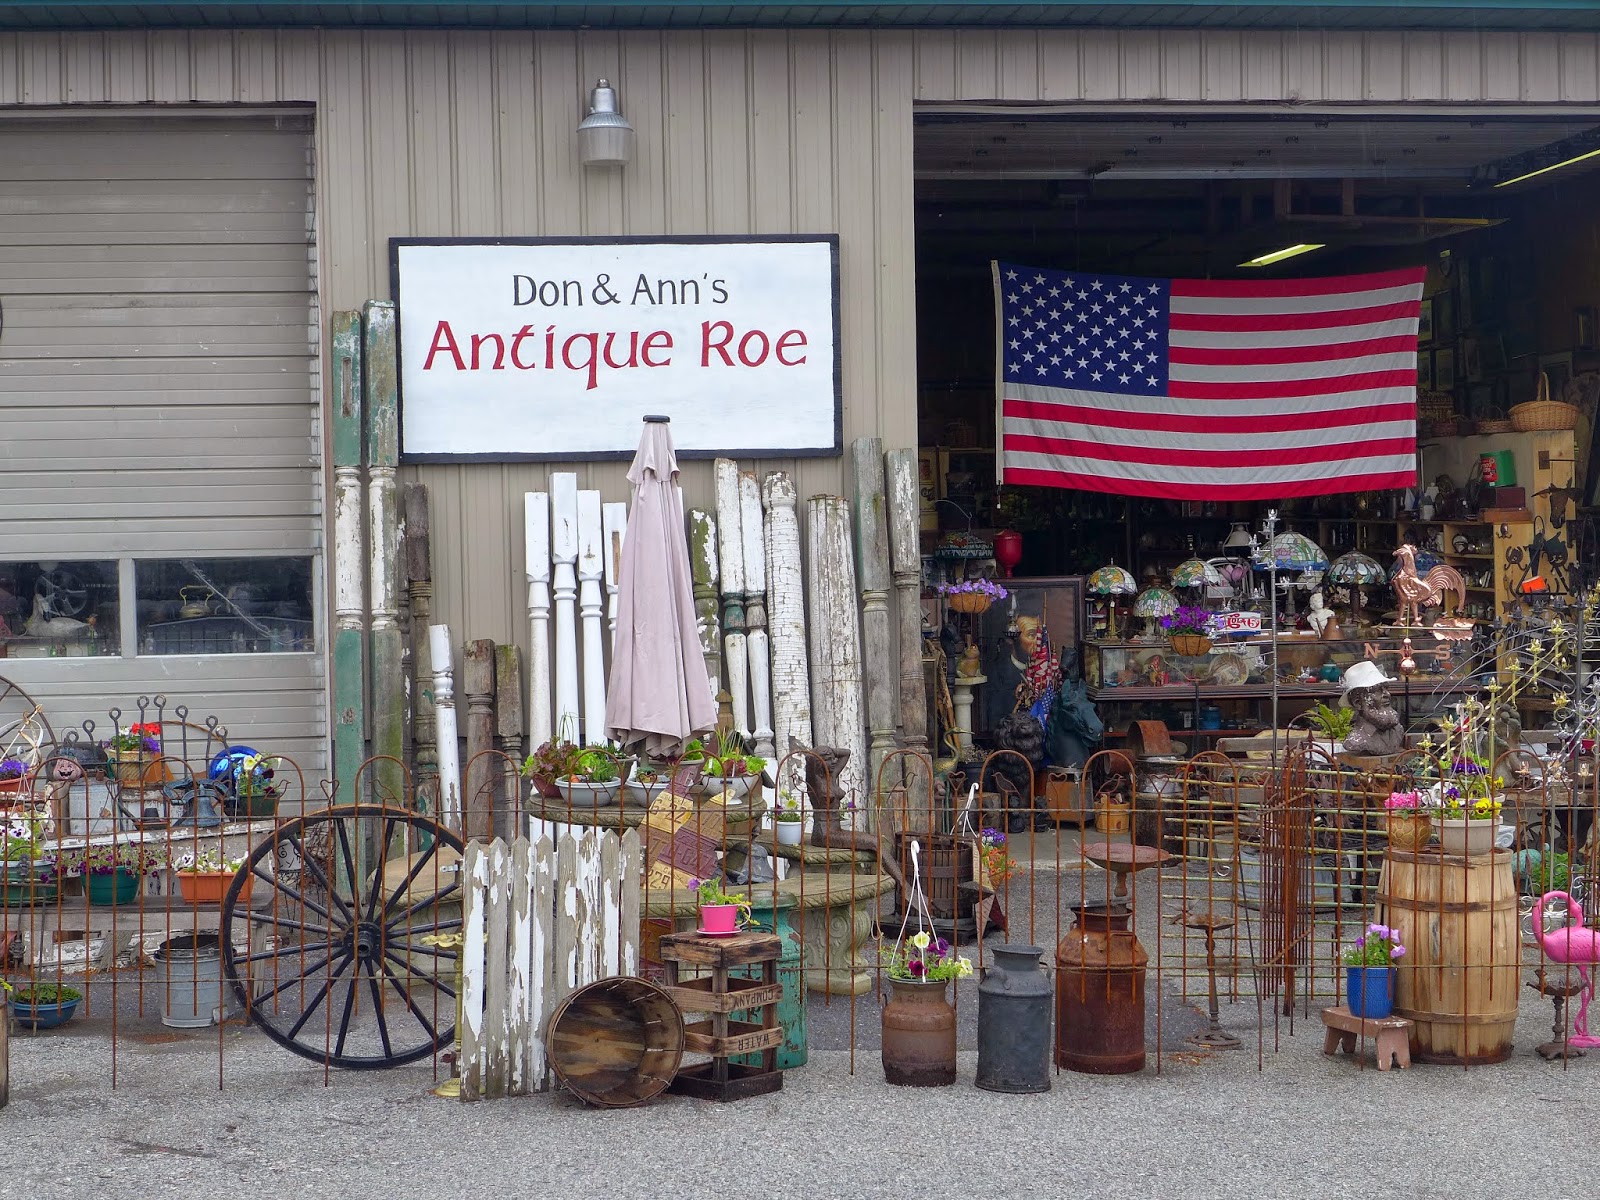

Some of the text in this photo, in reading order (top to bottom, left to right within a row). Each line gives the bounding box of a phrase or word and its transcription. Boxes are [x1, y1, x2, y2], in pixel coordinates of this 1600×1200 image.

[513, 272, 729, 307] Don & Ann's
[423, 320, 808, 391] Antique Roe
[733, 988, 774, 1008] COMPANY
[738, 1033, 770, 1051] WATER
